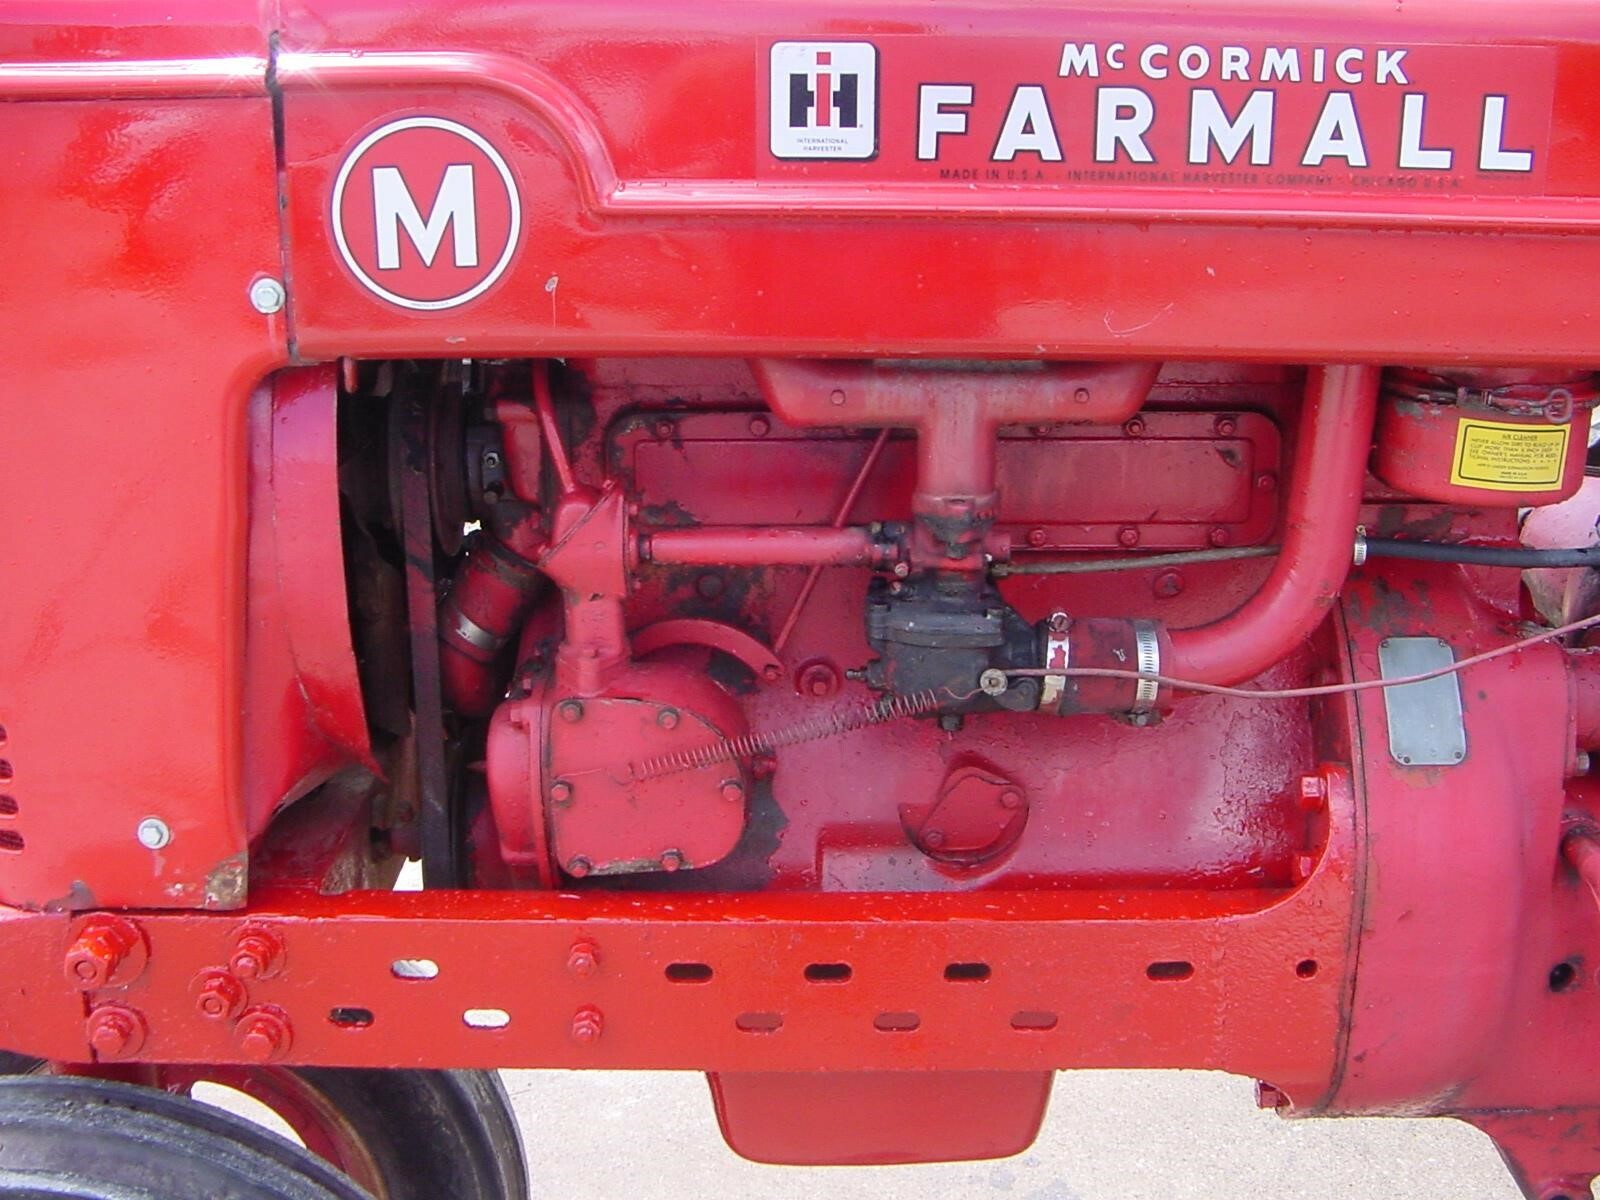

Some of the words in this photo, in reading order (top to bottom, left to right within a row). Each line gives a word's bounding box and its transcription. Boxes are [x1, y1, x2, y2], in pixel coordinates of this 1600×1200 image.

[796, 137, 849, 145] INTERNATIONAL
[916, 83, 1534, 173] FARMALL
[940, 168, 979, 181] MADE
[985, 169, 1000, 181] IN
[1067, 170, 1176, 184] INTERNATIONAL
[1182, 171, 1259, 185] HARVESTER
[1265, 172, 1333, 187] COMPANY
[371, 163, 480, 270] M
